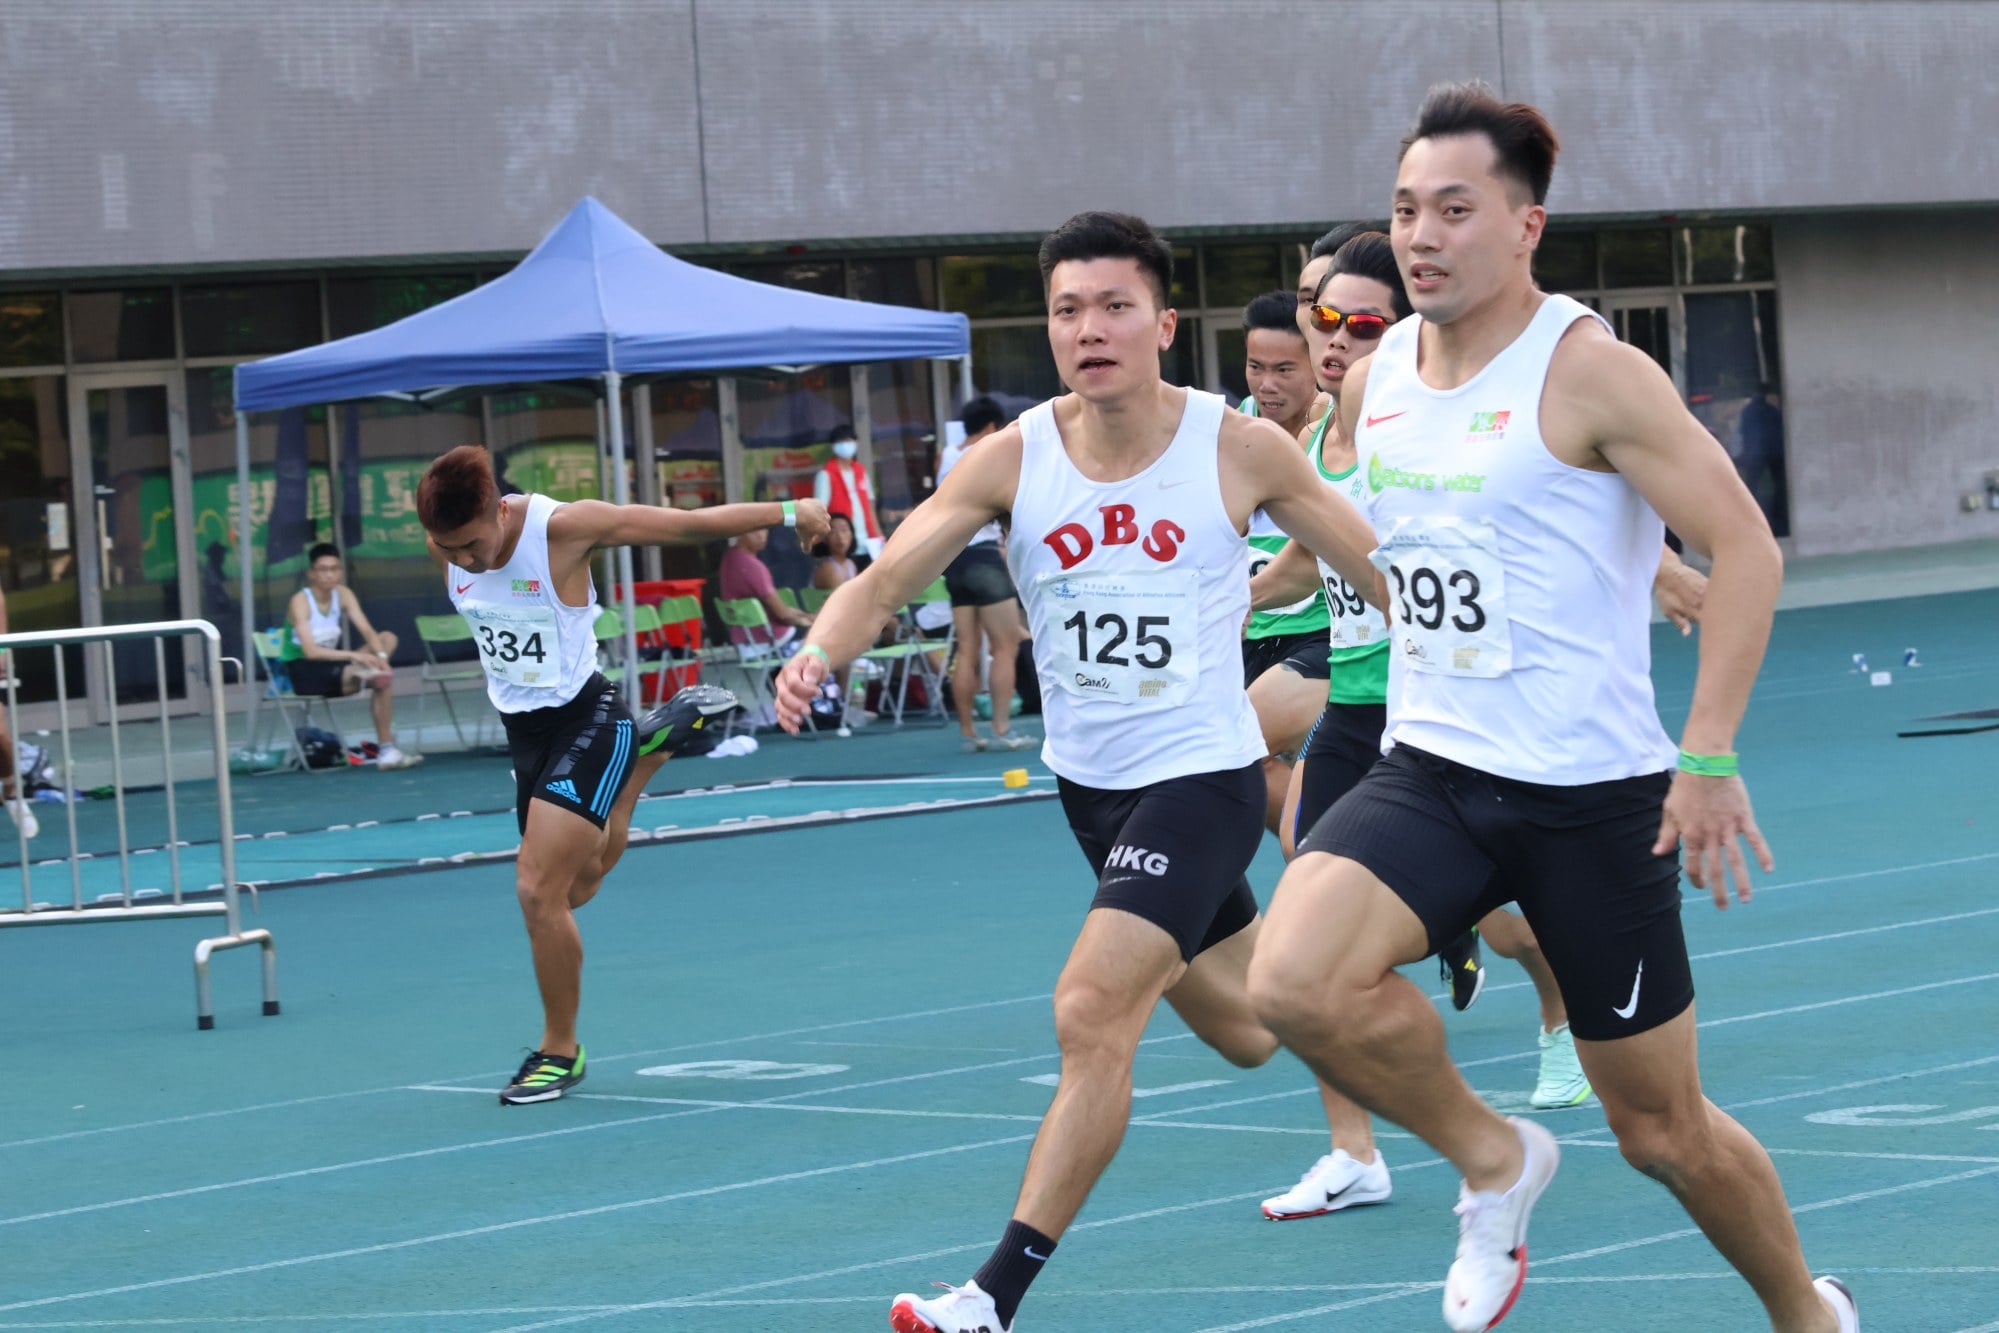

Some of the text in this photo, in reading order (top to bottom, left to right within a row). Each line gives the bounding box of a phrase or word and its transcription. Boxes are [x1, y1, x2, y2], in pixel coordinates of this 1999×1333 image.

[1043, 503, 1186, 570] DBS
[479, 625, 547, 664] 334
[1064, 610, 1172, 669] 125
[545, 783, 582, 804] adidas
[1104, 844, 1169, 876] HKG
